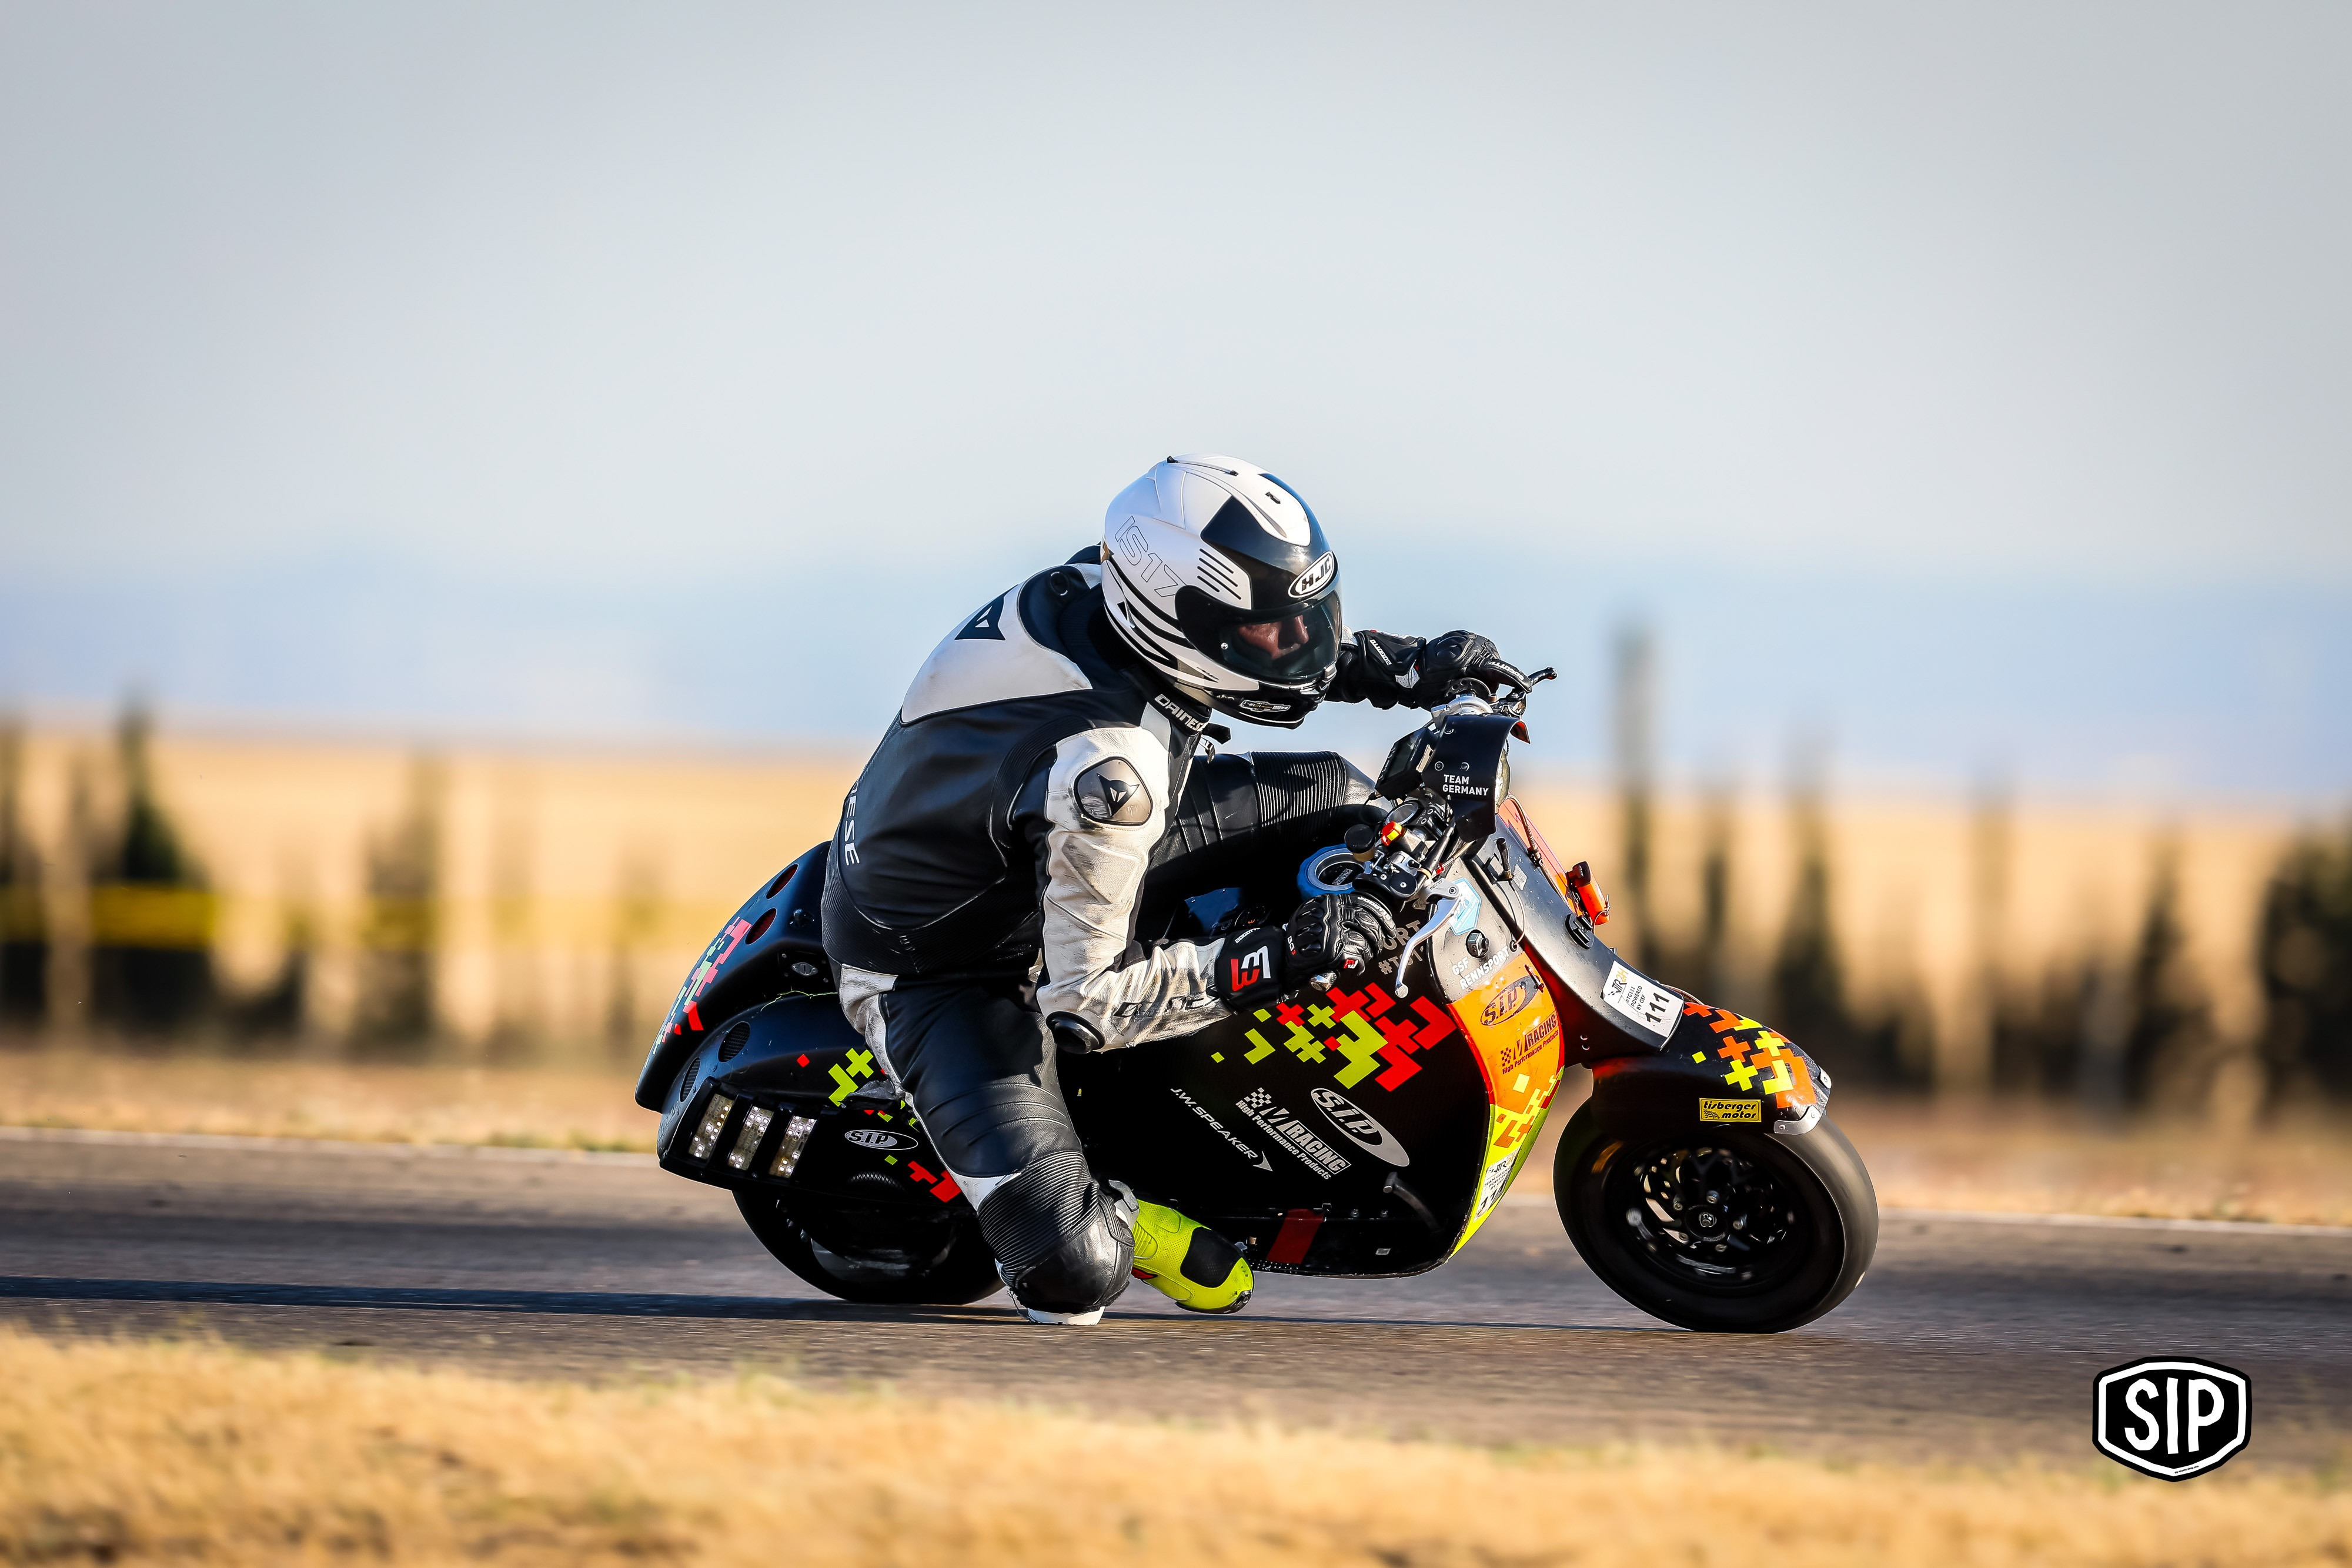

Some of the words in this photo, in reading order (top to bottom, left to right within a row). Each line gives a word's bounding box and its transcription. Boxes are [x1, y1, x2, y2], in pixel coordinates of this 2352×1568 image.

[1114, 515, 1188, 598] IS17
[1301, 556, 1331, 592] HJC
[1154, 694, 1204, 732] DAINES
[1442, 784, 1489, 796] GERMANY
[1444, 774, 1469, 785] TEAM
[1452, 956, 1469, 976] GSF
[1459, 945, 1509, 990] RENNSPORT
[1631, 985, 1643, 1007] POWERED
[1645, 992, 1670, 1023] 111
[1527, 1014, 1557, 1048] RACING
[1502, 1061, 1514, 1075] High
[1514, 1043, 1542, 1068] Performance
[1542, 1029, 1559, 1048] Products
[1720, 1111, 1757, 1119] motor
[1235, 1099, 1255, 1117] High
[1251, 1114, 1299, 1156] Performance
[1297, 1152, 1332, 1180] Products
[1285, 1123, 1347, 1172] RACING
[1496, 1166, 1511, 1179] GERMA
